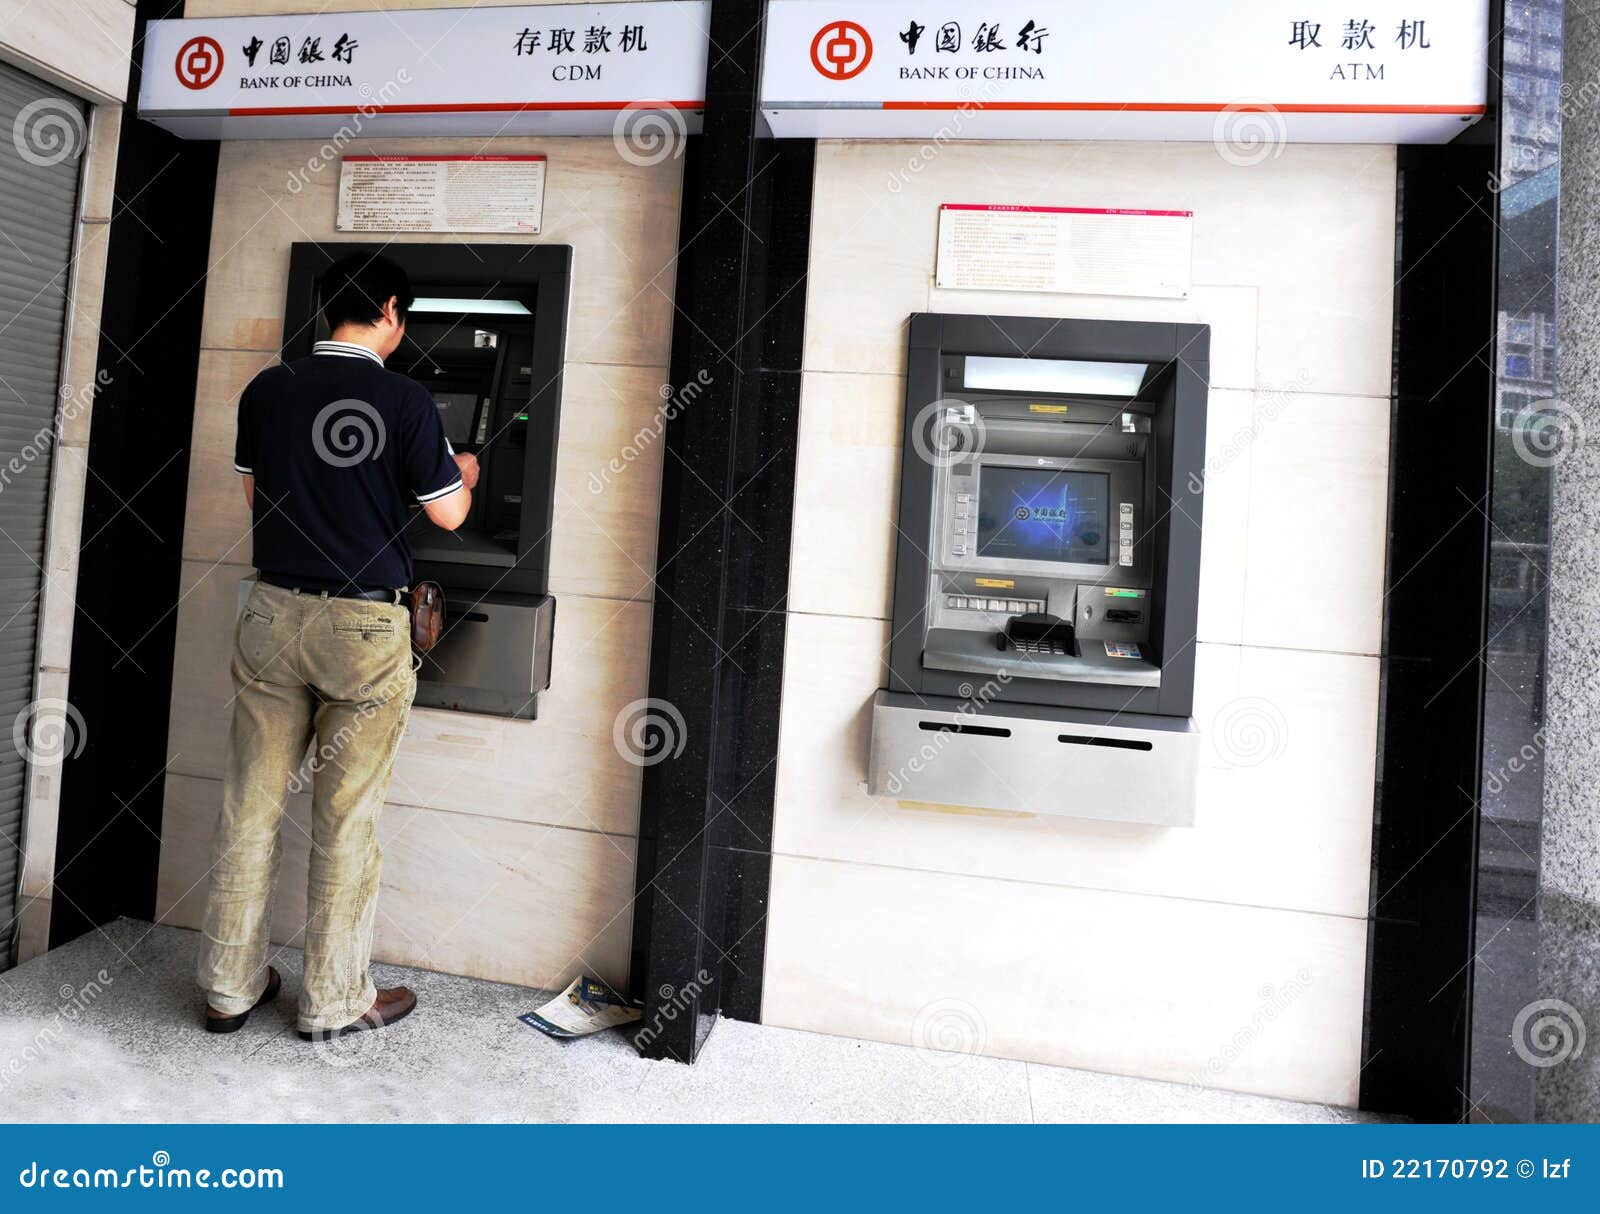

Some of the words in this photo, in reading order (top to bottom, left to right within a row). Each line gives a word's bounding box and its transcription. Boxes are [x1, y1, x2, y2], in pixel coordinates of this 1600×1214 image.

[513, 24, 648, 57] 存取款机
[1287, 18, 1432, 51] 取款机
[551, 64, 602, 82] CDM
[899, 66, 950, 80] BANK
[955, 66, 979, 80] OF
[983, 66, 1045, 80] CHINA
[1329, 63, 1385, 80] ATM
[240, 76, 280, 89] BANK
[283, 76, 302, 88] OF
[304, 75, 353, 88] CHINA
